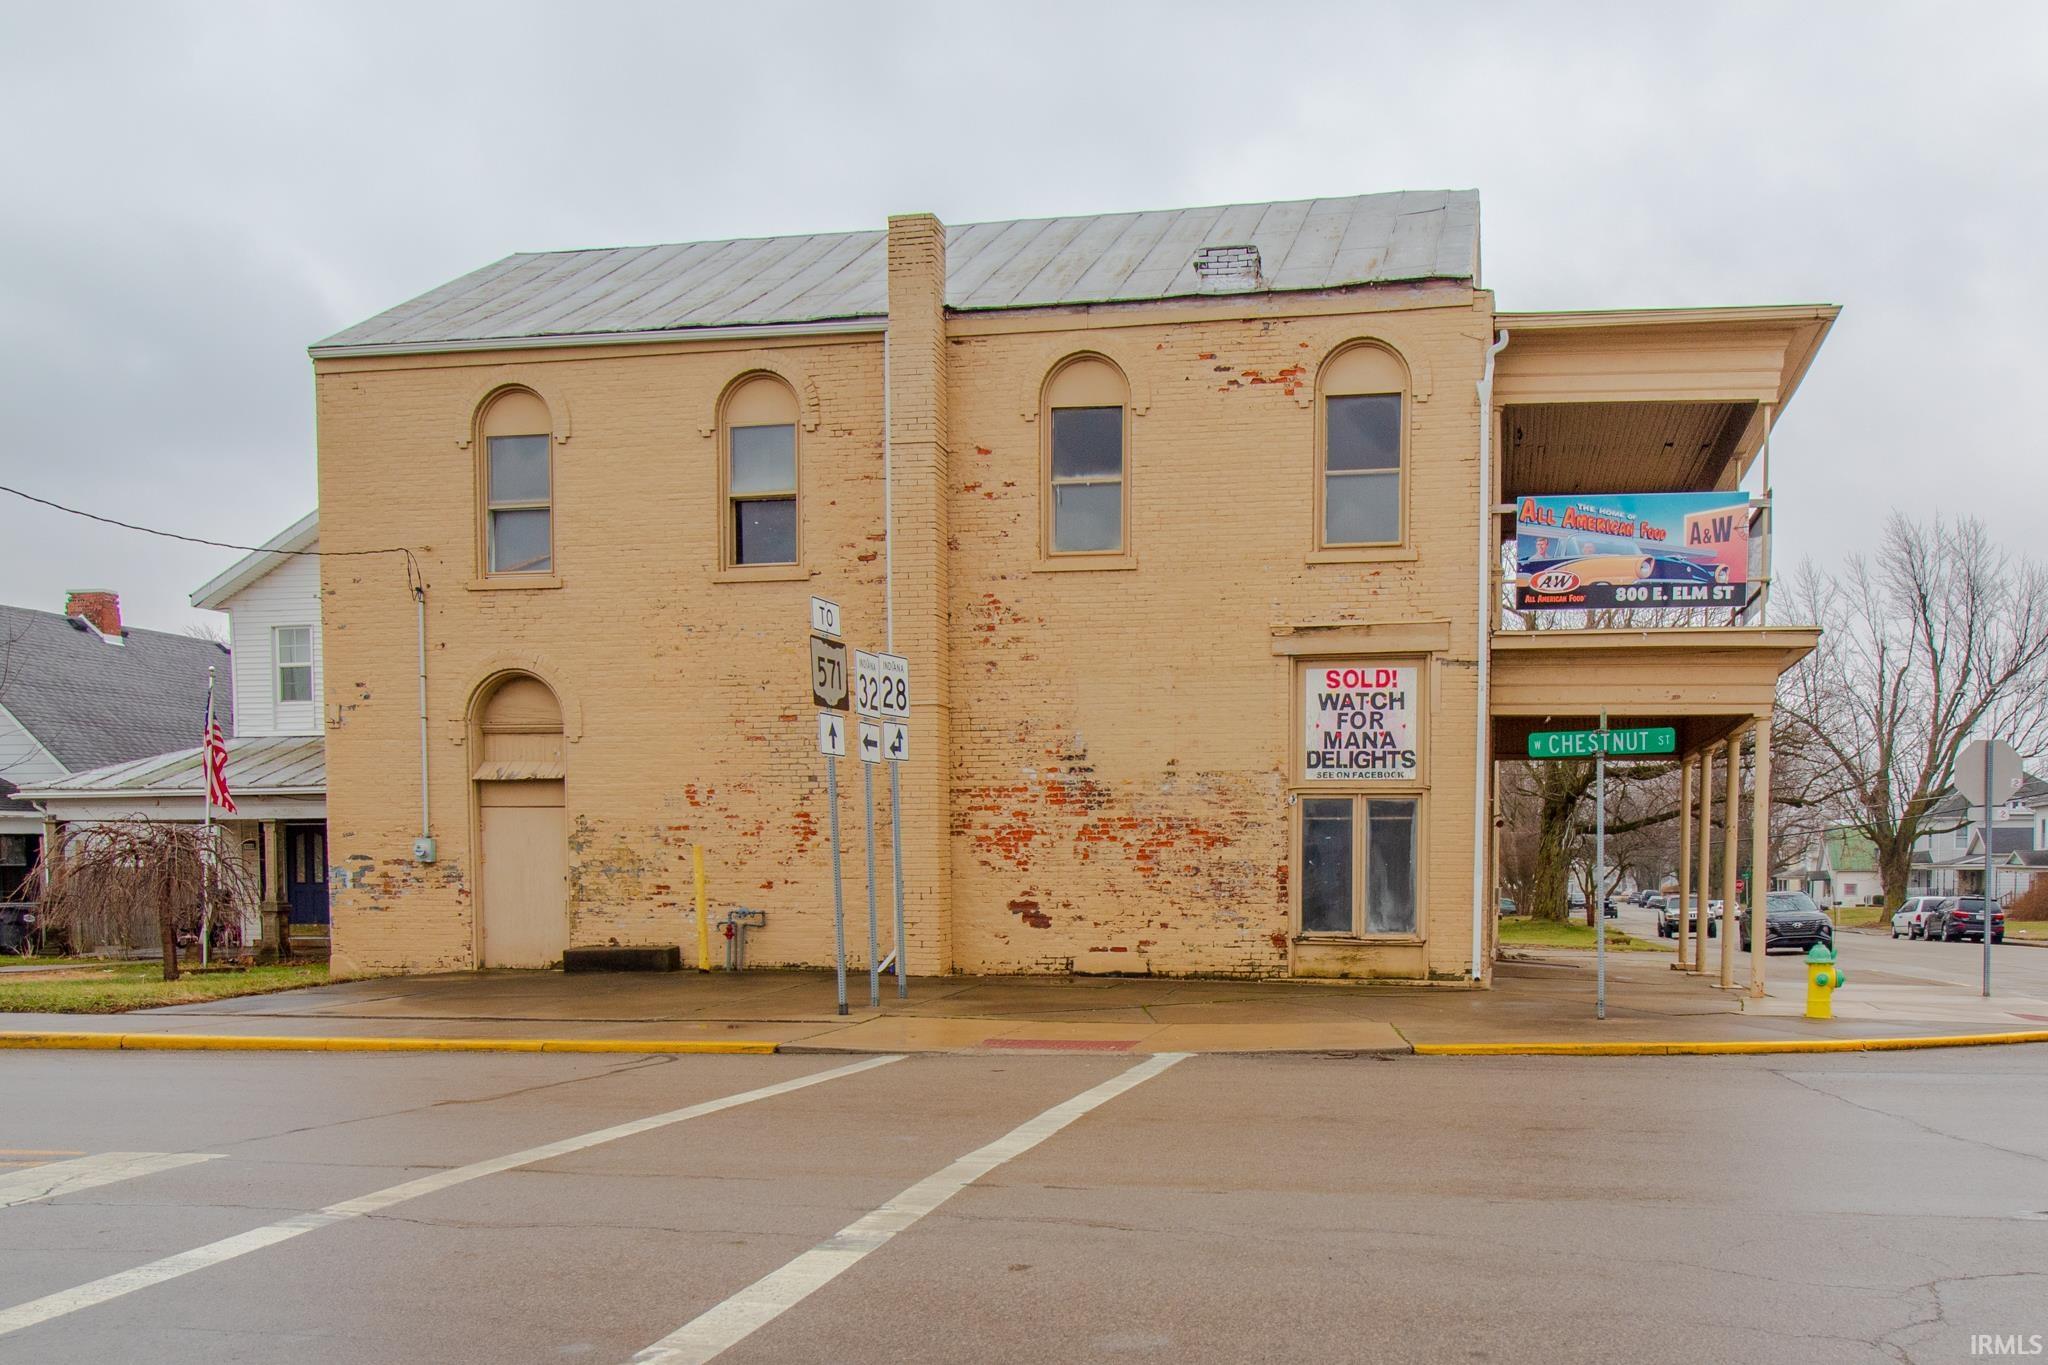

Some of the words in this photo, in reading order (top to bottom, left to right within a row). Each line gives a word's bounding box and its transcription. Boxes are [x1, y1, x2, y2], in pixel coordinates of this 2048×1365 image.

[1519, 498, 1556, 526] ALL
[1561, 506, 1635, 537] AMERICAN
[1640, 519, 1667, 541] FOOD
[1577, 503, 1596, 513] THE
[1598, 507, 1626, 518] HOME
[1626, 512, 1637, 520] OF
[1690, 515, 1733, 545] A&W
[1525, 594, 1536, 603] ALL
[1615, 586, 1649, 602] 800
[1652, 586, 1668, 601] E.
[1672, 585, 1708, 600] ELM
[1712, 584, 1735, 600] ST
[819, 606, 834, 627] TO
[817, 656, 842, 690] 571
[882, 661, 905, 673] INDIANA
[1326, 669, 1398, 689] SOLD!
[859, 673, 879, 711] 32
[882, 675, 907, 711] 28
[1318, 691, 1405, 711] WATCH
[1337, 711, 1384, 730] FOR
[1324, 731, 1397, 749] MANA
[1534, 740, 1541, 750] W
[1548, 731, 1649, 754] CHESTNUT
[1658, 735, 1671, 746] ST
[1306, 750, 1416, 769] DELIGHTS
[1316, 771, 1334, 779] SEE
[1336, 771, 1350, 779] ON
